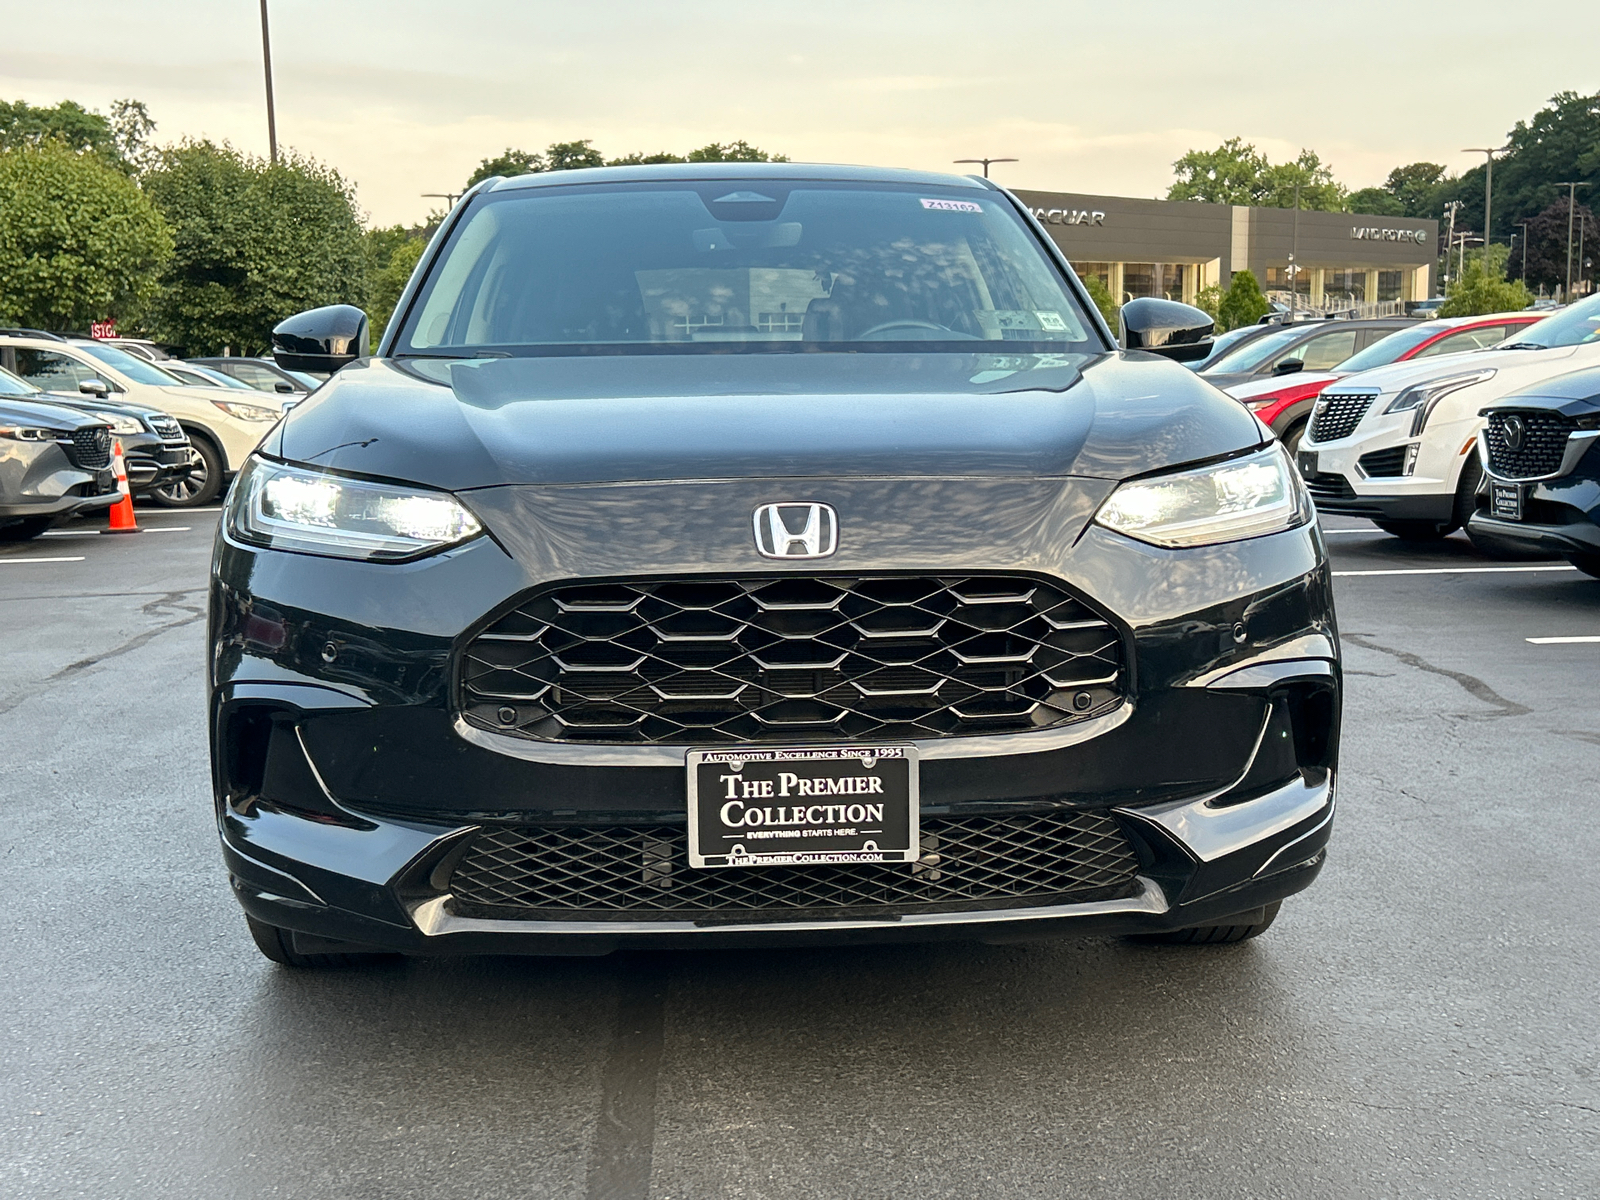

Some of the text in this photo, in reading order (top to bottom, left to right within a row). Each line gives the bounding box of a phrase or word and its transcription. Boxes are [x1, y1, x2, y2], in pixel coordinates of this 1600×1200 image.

[704, 748, 902, 762] AUTOMOTIVE EXCELLENCE SINCE 1995
[719, 772, 885, 800] THE PREMIER
[720, 800, 885, 828] COLLECTION
[746, 828, 859, 840] EVERYTHING STARTS HERE.
